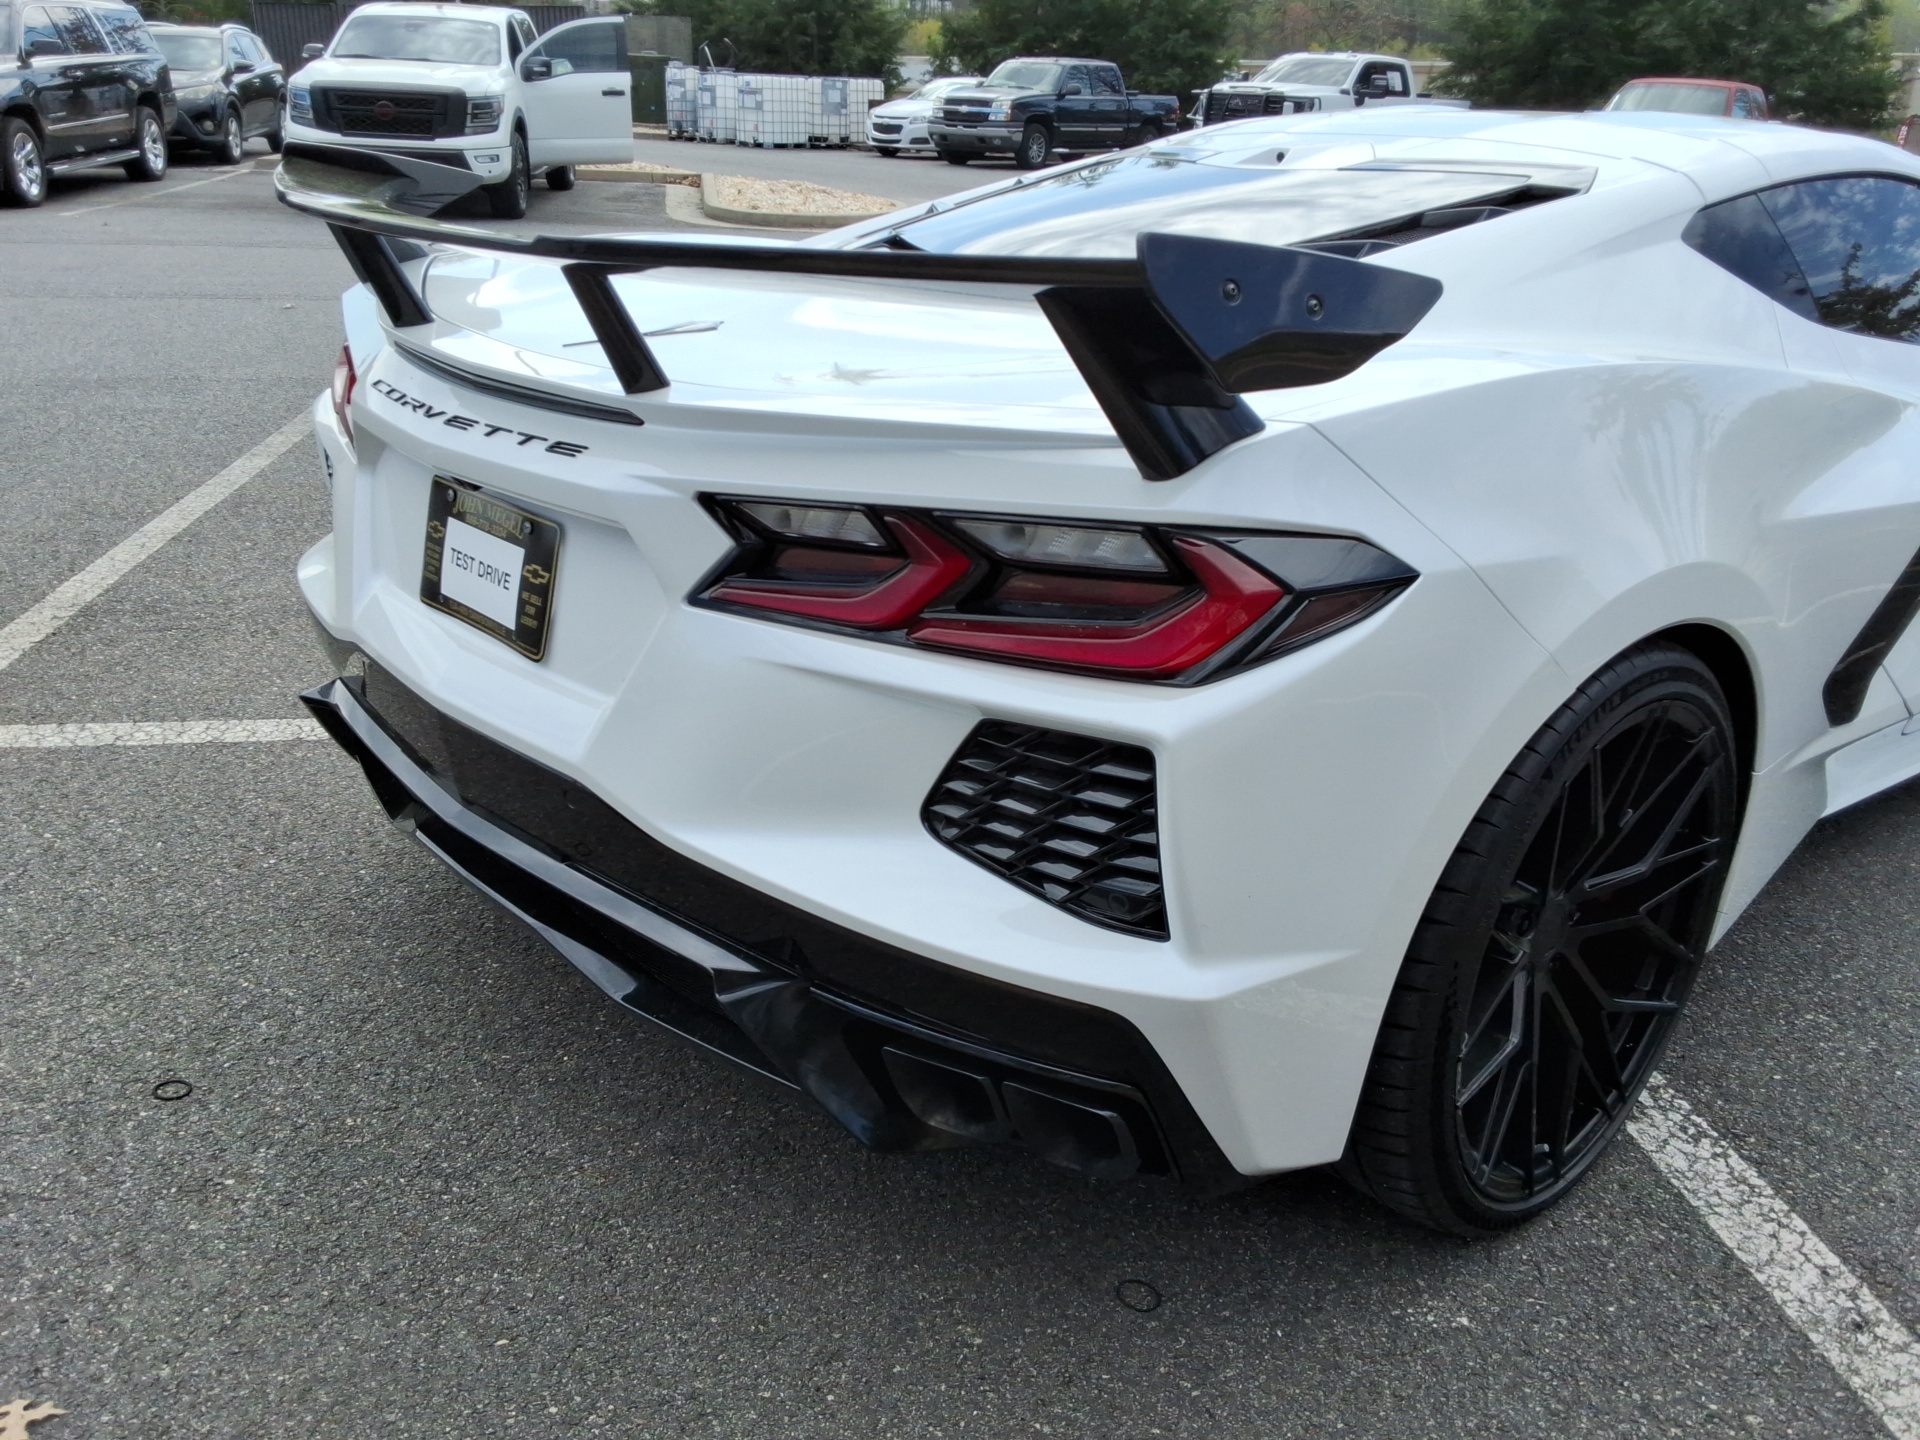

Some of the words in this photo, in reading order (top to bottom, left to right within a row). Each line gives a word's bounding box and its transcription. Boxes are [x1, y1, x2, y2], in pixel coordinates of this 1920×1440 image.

[371, 379, 589, 457] CORVETTE
[452, 493, 484, 514] JOHN
[485, 503, 524, 539] MEGEL
[450, 547, 476, 573] TEST
[478, 561, 511, 590] DRIVE
